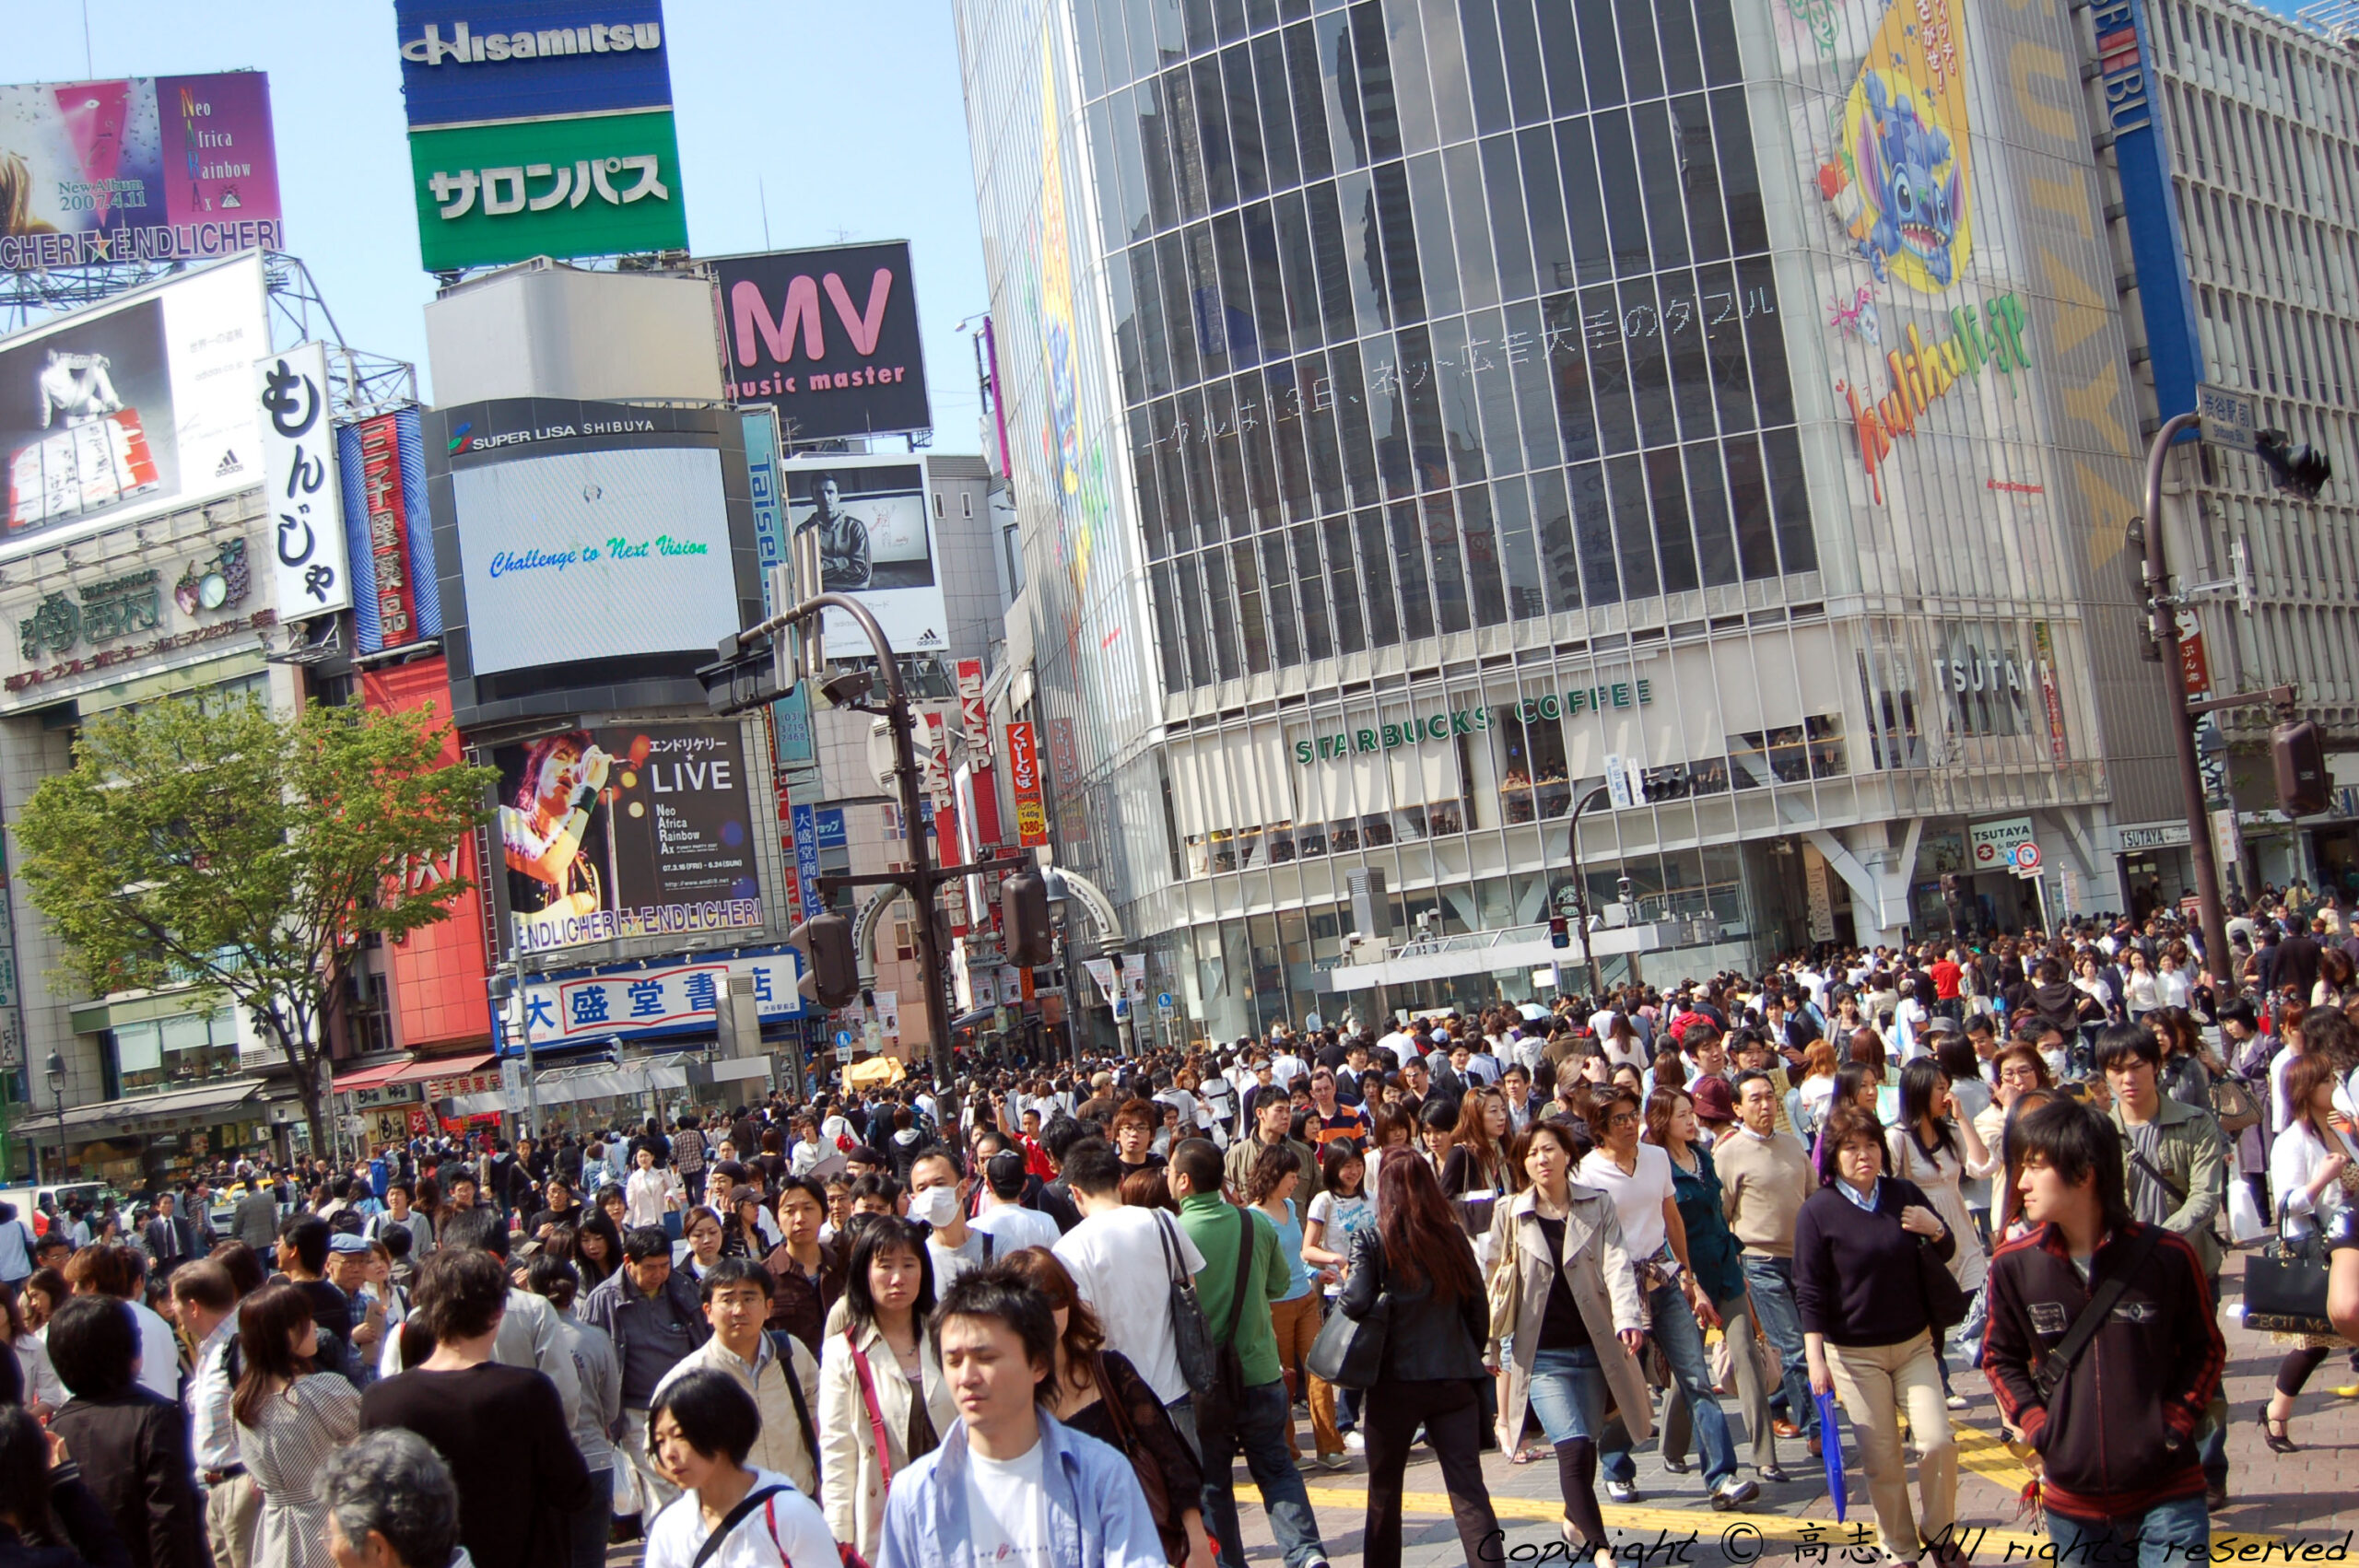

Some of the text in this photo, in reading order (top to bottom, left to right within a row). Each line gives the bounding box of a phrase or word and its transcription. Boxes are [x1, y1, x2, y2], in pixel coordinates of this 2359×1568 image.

[401, 22, 661, 65] Hisamitsu
[2088, 0, 2151, 138] EIBU
[181, 87, 211, 119] Neo
[185, 120, 233, 149] Africa
[187, 150, 252, 181] Rainbow
[58, 178, 144, 195] New Album
[191, 182, 212, 213] Ax
[428, 154, 669, 219] サロンパス
[60, 193, 147, 212] 2007.4.11
[112, 219, 284, 261] ENDLICHERI
[714, 268, 893, 368] MV
[809, 364, 907, 393] master
[472, 420, 655, 451] SUPER LISA SHIBUYA
[215, 462, 244, 477] adidas
[262, 358, 334, 603] もんじゃ
[749, 451, 784, 570] Taisei
[360, 424, 408, 635] 三千里薬品
[489, 534, 708, 579] Challenge to Next Vision
[917, 638, 943, 647] adidas
[1933, 658, 2054, 693] TSUTAYA
[959, 673, 992, 774] さくらや
[1296, 679, 1652, 766] STARBUCKS COFFEE
[649, 738, 727, 753] エンドリケリー
[651, 760, 734, 793] LIVE
[656, 803, 676, 817] Neo
[658, 816, 687, 830] Africa
[659, 828, 700, 842] Rainbow
[661, 841, 675, 855] Ax
[1973, 825, 2030, 842] TSUTAYA
[2120, 827, 2165, 847] TSUTAYA
[641, 897, 764, 932] ENDLICHERI
